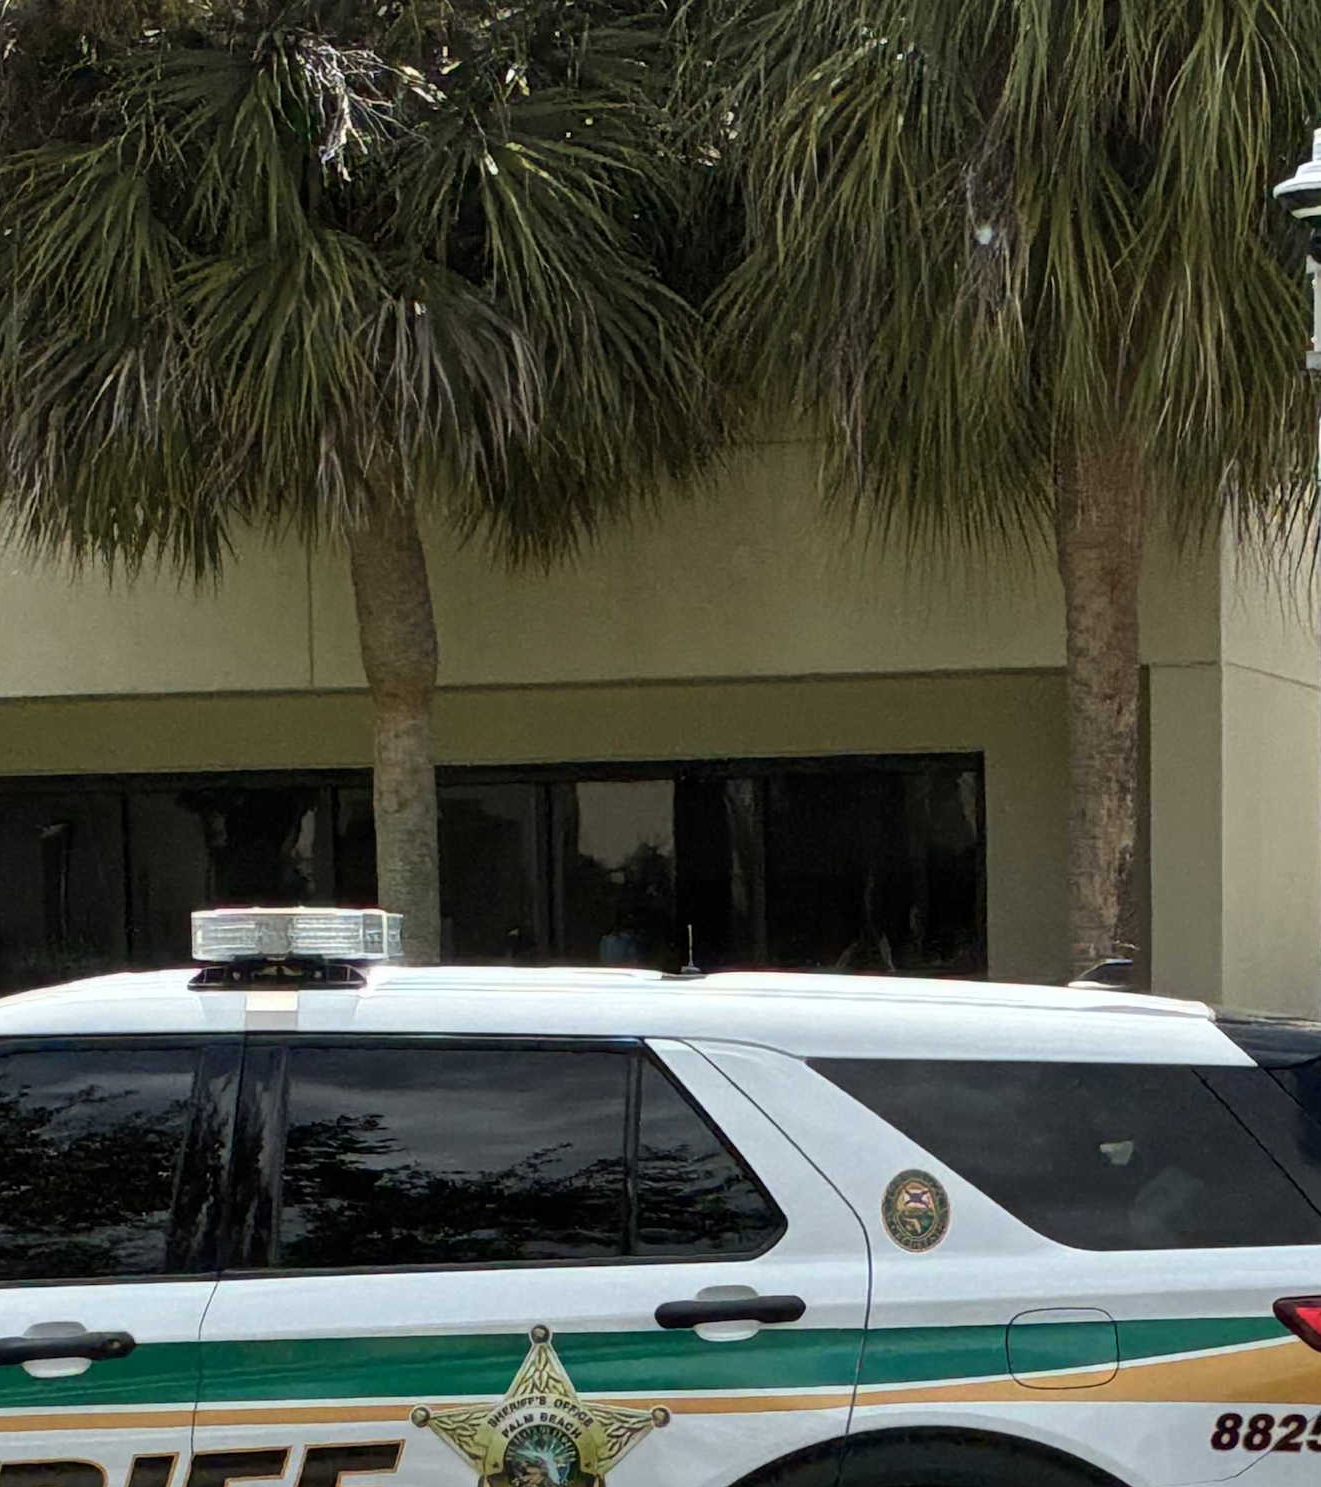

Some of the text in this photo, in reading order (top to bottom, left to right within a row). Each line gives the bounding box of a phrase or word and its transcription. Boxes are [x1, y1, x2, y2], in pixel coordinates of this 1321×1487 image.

[487, 1396, 594, 1428] SHERIFF'S OFFICE
[501, 1412, 582, 1440] PALM BEACH
